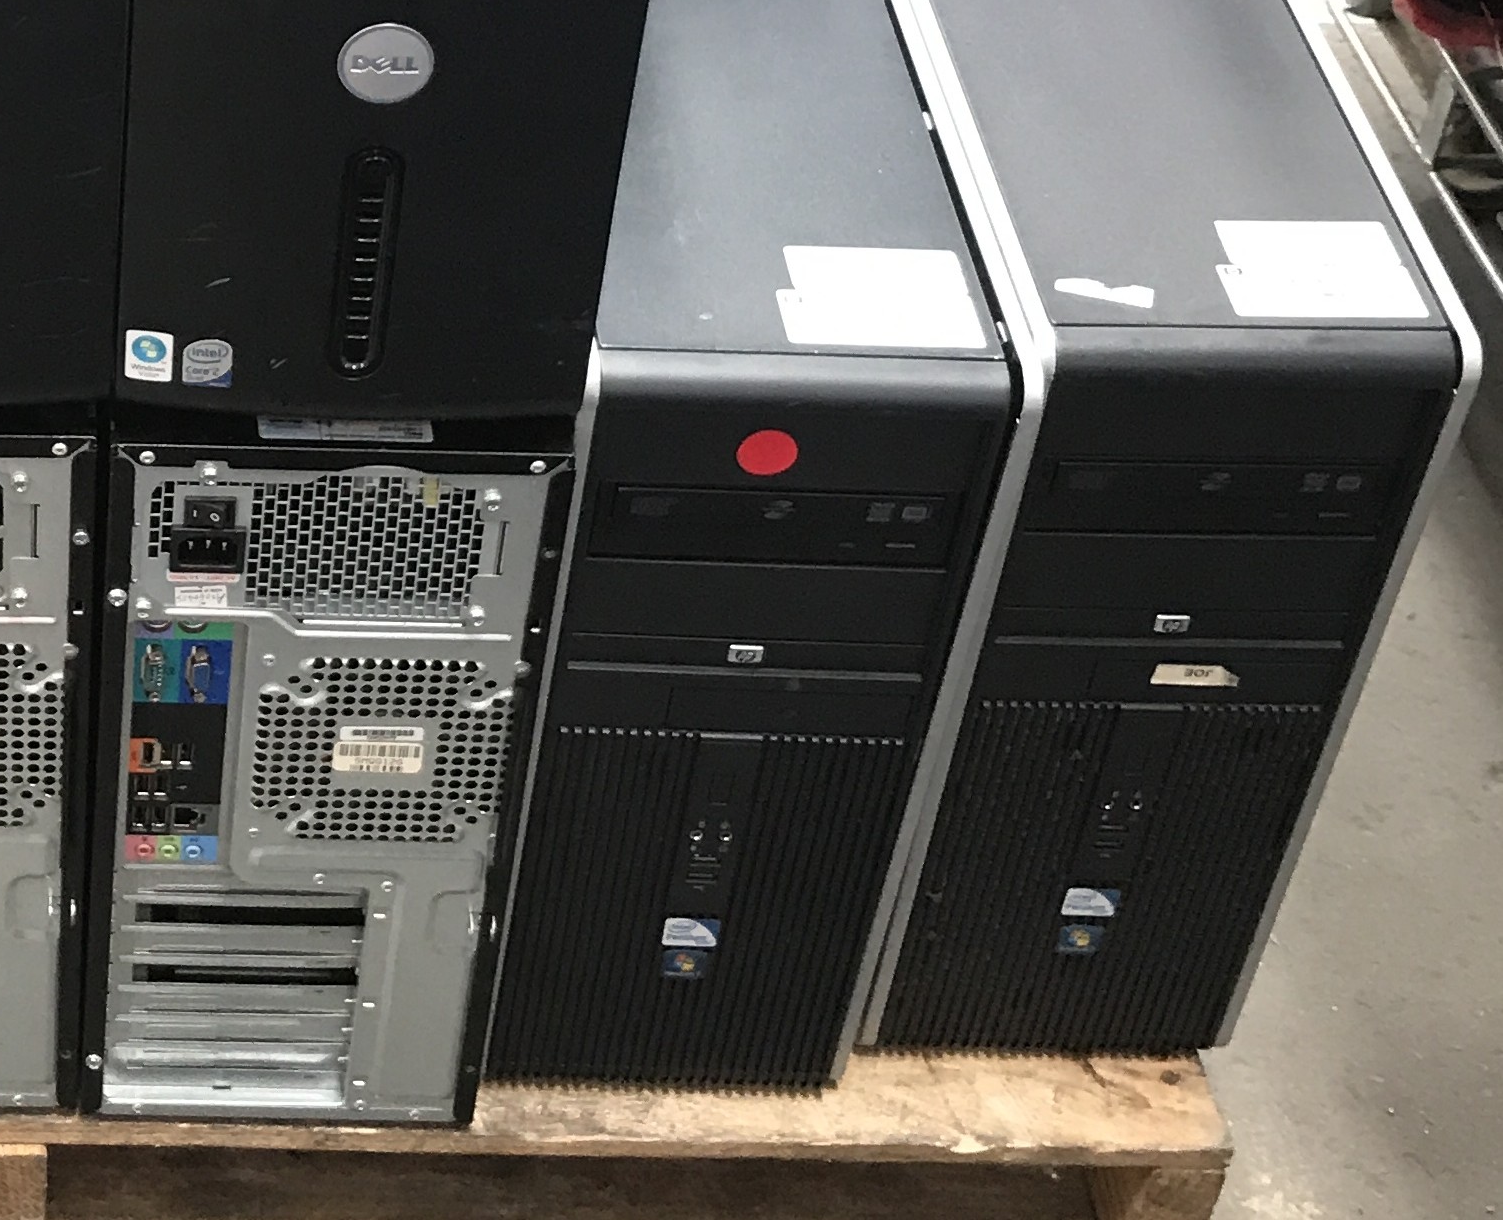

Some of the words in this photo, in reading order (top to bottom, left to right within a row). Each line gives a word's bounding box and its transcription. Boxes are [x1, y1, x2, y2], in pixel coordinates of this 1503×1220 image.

[350, 54, 420, 74] DELL
[192, 347, 222, 357] intel
[130, 363, 166, 373] Windows
[185, 365, 210, 376] Core
